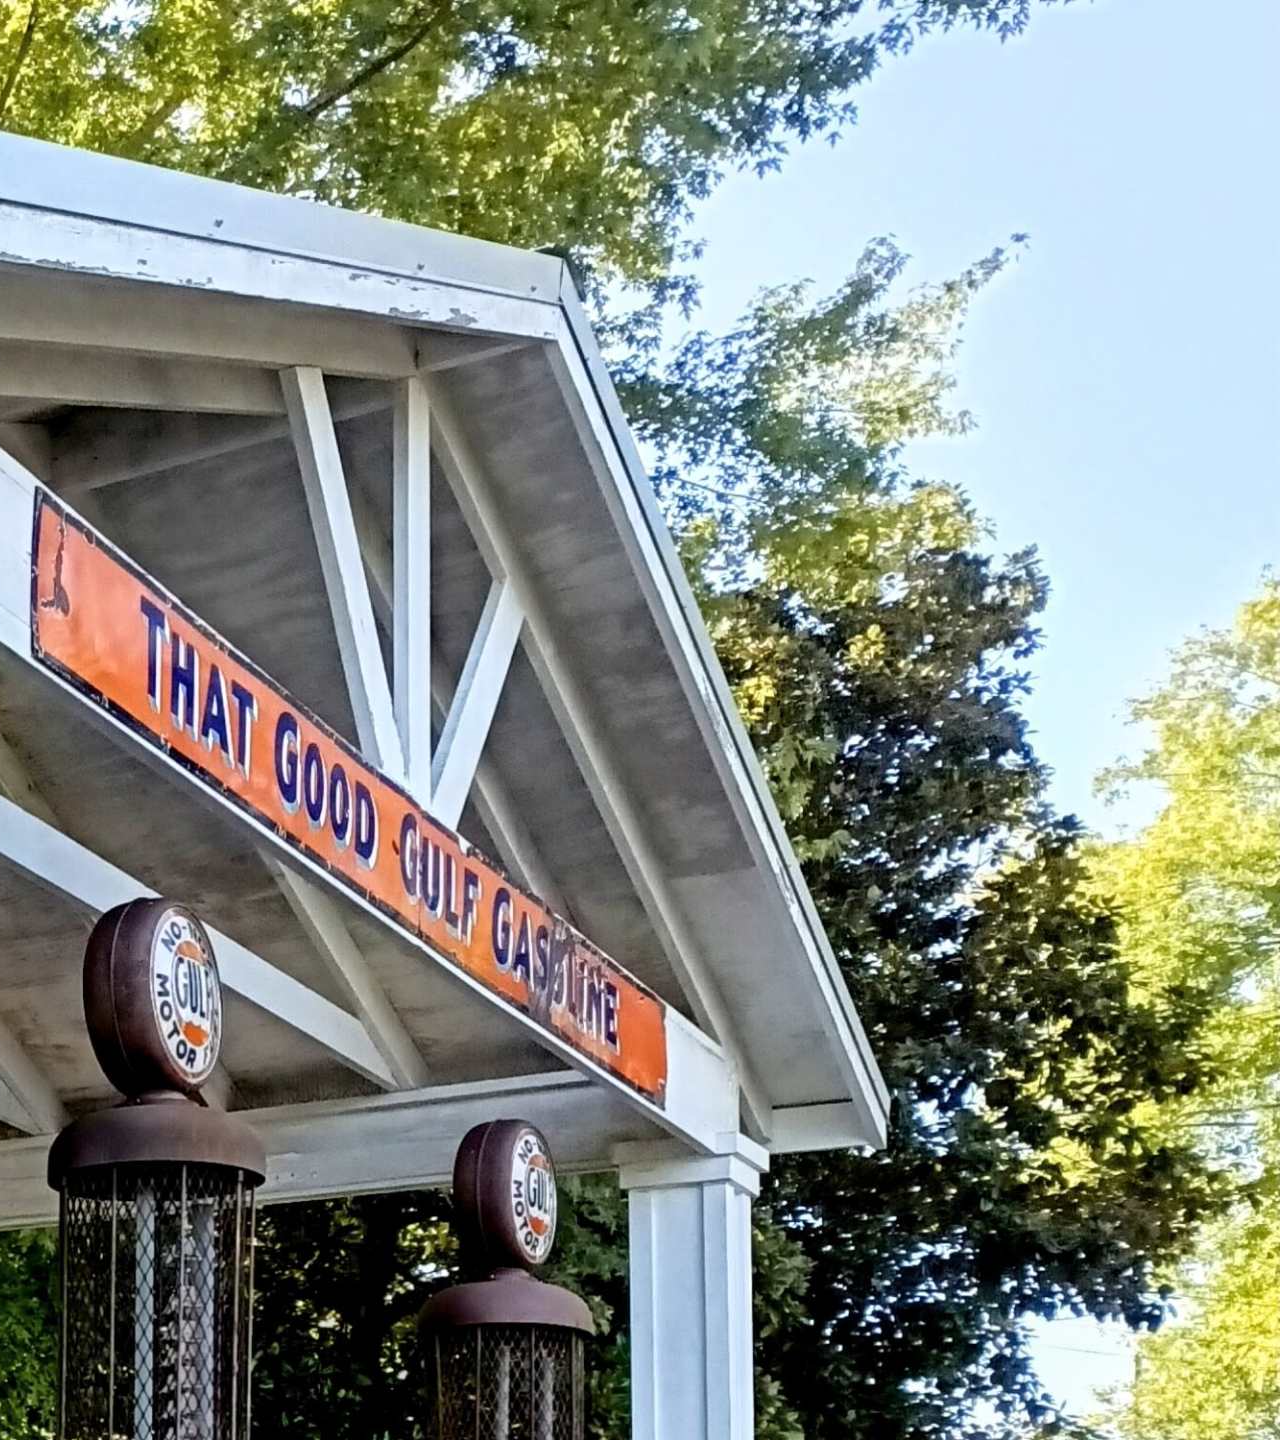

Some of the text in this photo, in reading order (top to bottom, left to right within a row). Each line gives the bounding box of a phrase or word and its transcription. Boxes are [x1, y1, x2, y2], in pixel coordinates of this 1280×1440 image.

[141, 595, 258, 780] THAT
[274, 711, 378, 870] GOOD
[399, 813, 482, 947] GULF
[156, 973, 197, 1069] MOTOR
[513, 1179, 539, 1253] MOTOR
